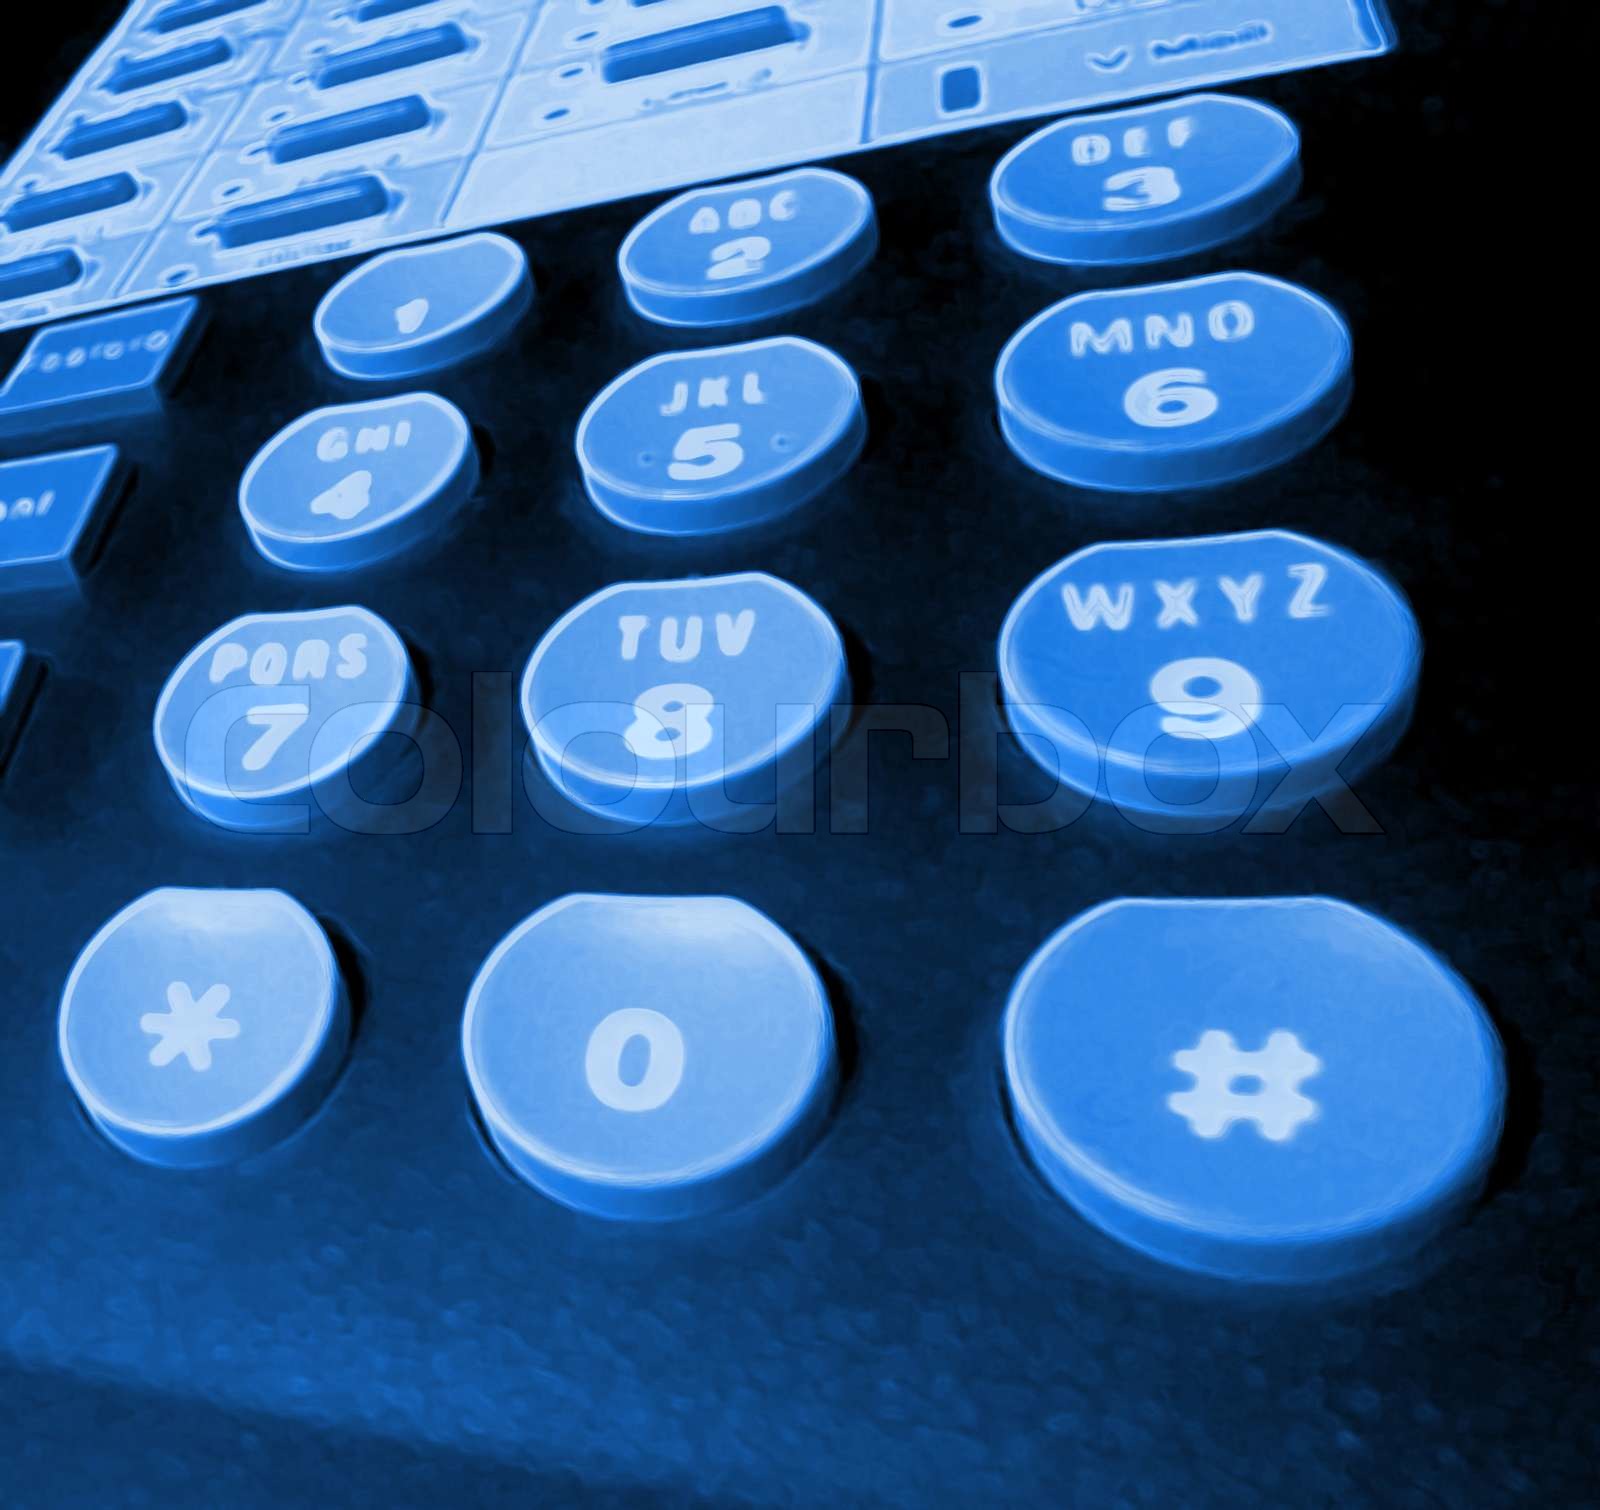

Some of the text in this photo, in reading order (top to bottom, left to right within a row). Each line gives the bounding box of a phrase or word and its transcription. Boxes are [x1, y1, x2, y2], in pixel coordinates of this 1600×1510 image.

[1104, 166, 1181, 211] 3
[706, 236, 771, 280] 2
[1070, 300, 1255, 358] MNO
[1124, 368, 1219, 428] 6
[667, 423, 744, 481] 5
[310, 470, 372, 520] 4
[1061, 562, 1331, 632] WXYZ
[618, 608, 757, 662] TUV
[624, 683, 714, 760] 8
[1149, 657, 1263, 740] 9
[241, 703, 310, 771] 7
